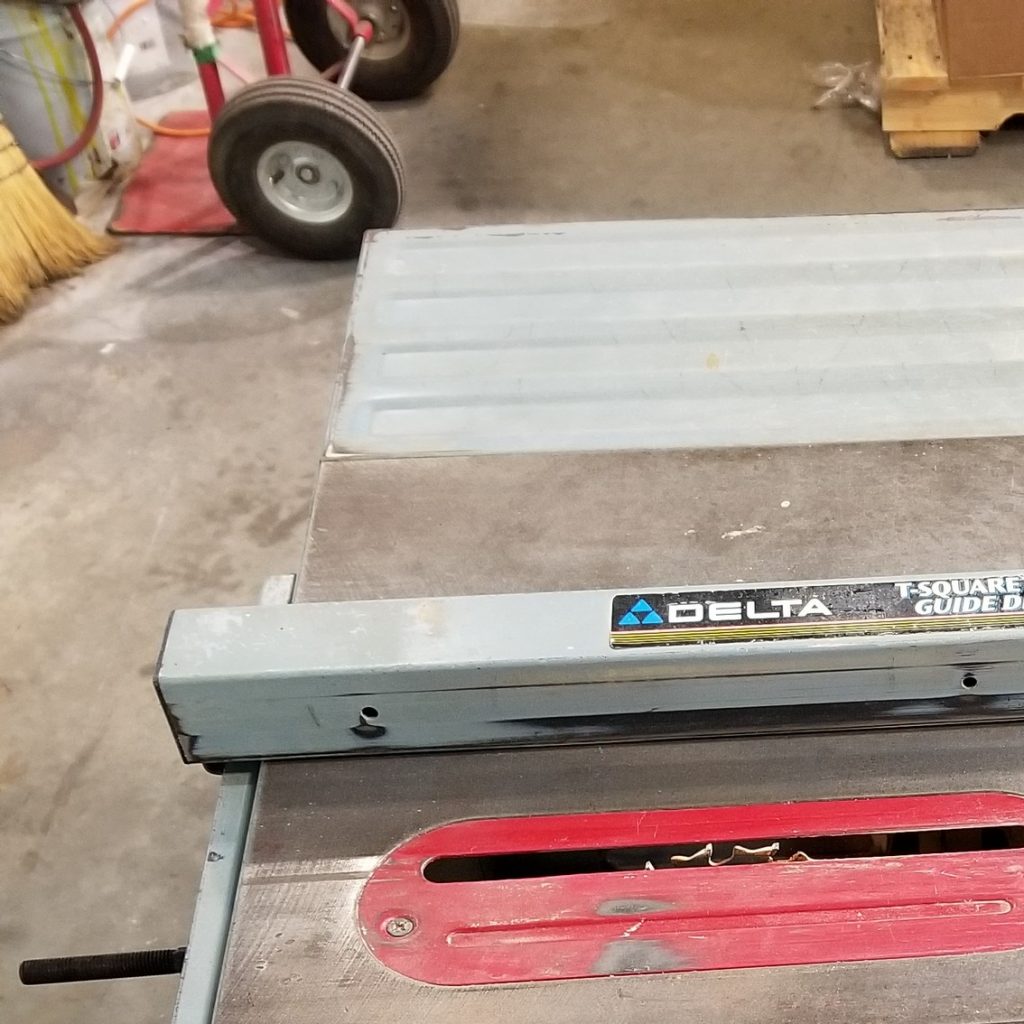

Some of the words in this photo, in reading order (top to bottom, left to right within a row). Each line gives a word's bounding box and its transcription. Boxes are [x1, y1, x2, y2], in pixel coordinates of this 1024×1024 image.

[894, 576, 1024, 600] T-SQUARE
[668, 598, 833, 623] DELTA
[914, 595, 999, 616] GUIDE
